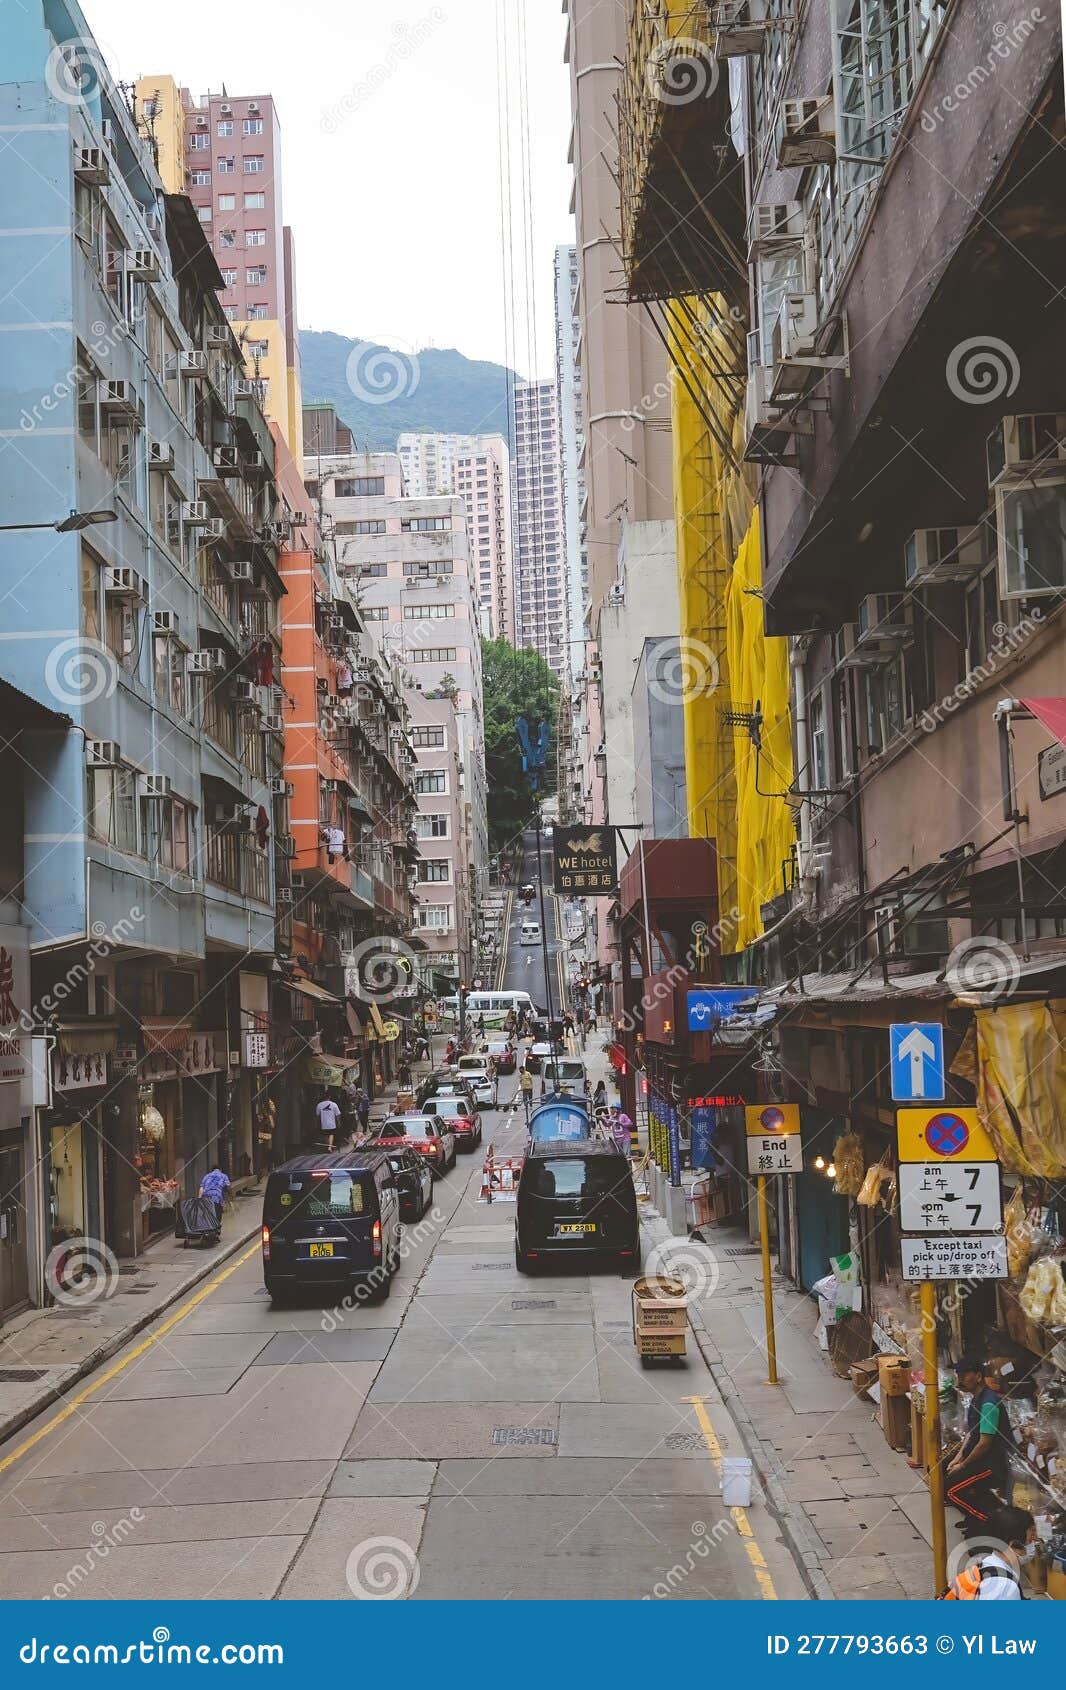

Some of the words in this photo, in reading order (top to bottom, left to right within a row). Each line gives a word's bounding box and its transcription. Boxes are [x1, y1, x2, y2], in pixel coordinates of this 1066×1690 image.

[559, 857, 577, 869] WE
[581, 856, 612, 867] hotel
[762, 1140, 786, 1151] End
[758, 1154, 792, 1170] 終止
[924, 1167, 942, 1175] am
[964, 1168, 980, 1190] 7
[920, 1179, 948, 1191] 上午
[921, 1214, 950, 1226] 下午
[925, 1203, 943, 1212] pm
[966, 1204, 981, 1226] 7
[925, 1241, 961, 1251] Except
[963, 1240, 982, 1250] taxi
[913, 1252, 934, 1262] pick
[937, 1251, 977, 1261] up/drop
[980, 1250, 996, 1260] off
[908, 1263, 1002, 1276] 的士上落客除外
